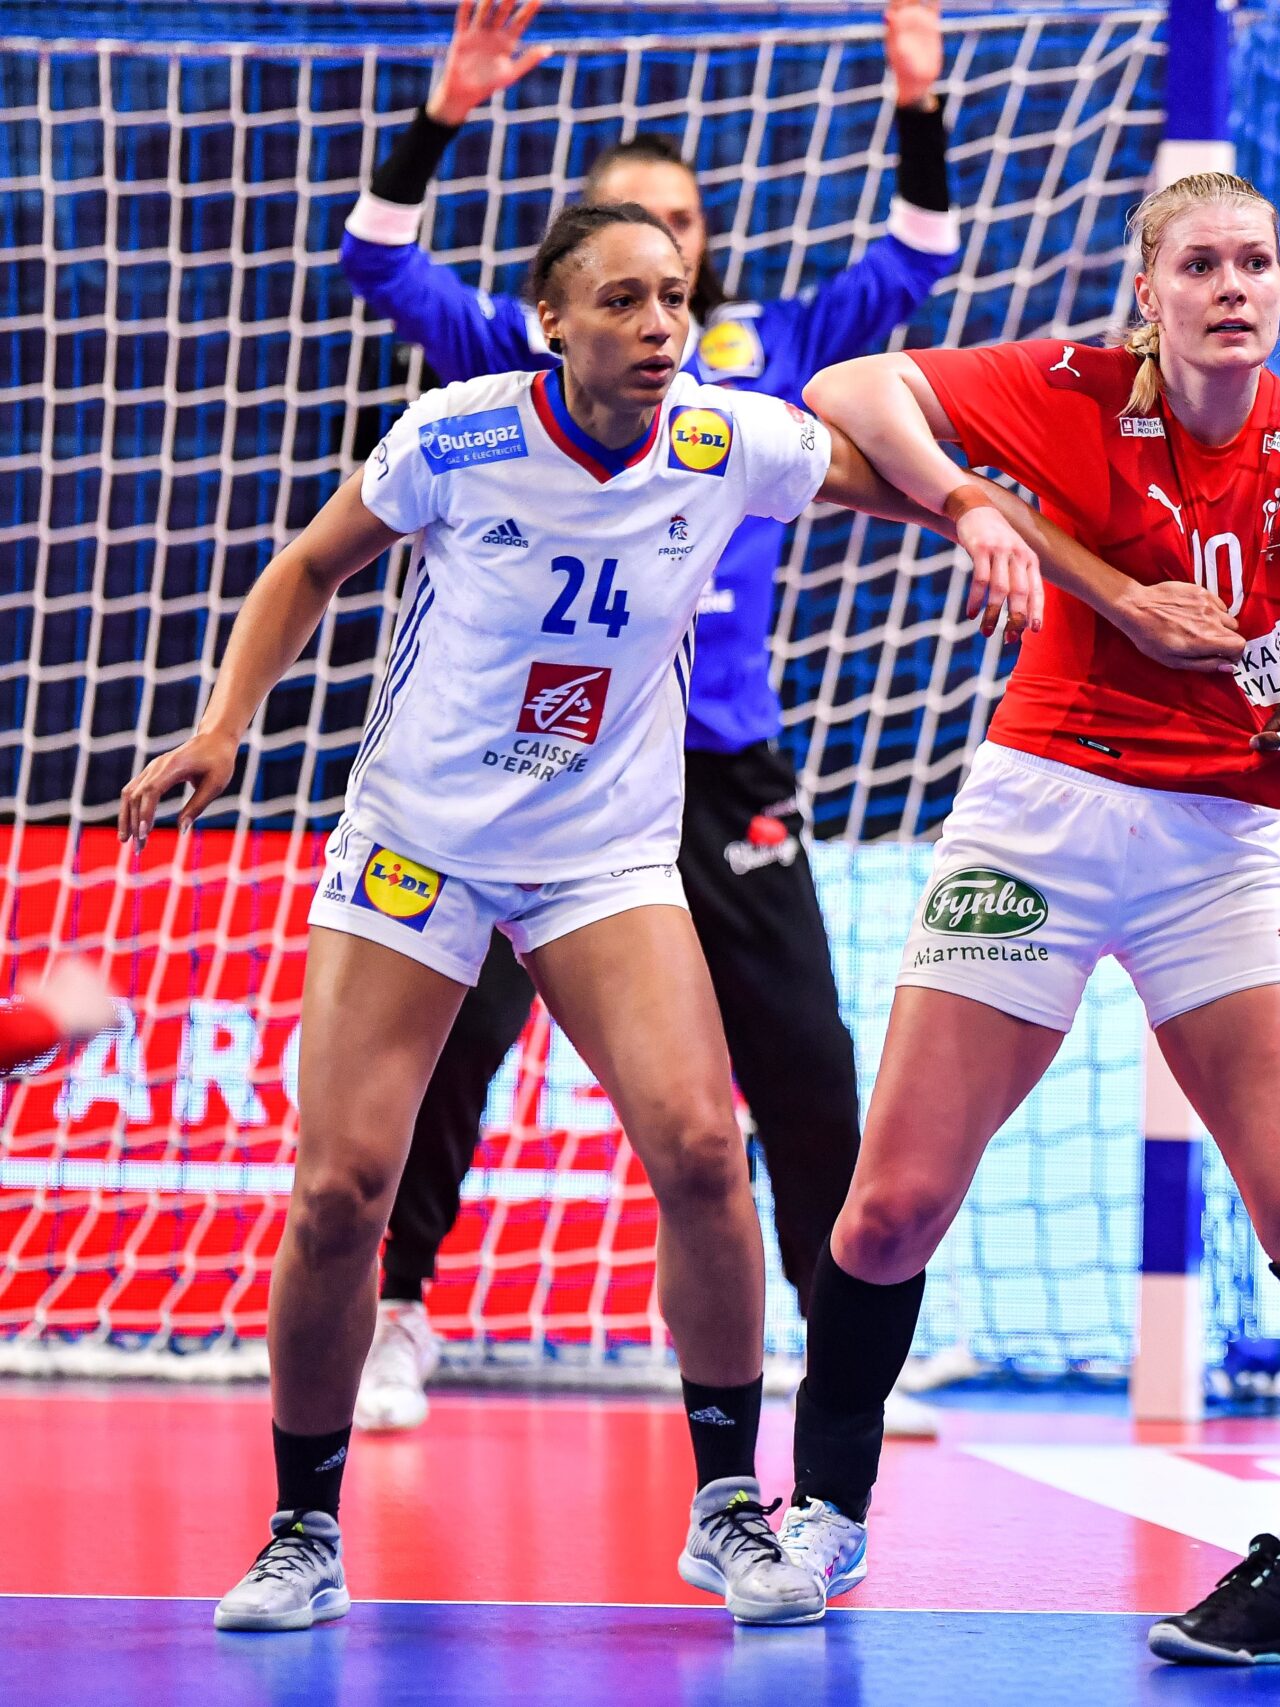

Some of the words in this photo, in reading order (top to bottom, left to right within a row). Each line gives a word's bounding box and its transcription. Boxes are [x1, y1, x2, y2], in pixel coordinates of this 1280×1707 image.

[437, 425, 520, 453] Butagaz
[482, 534, 529, 548] adidas
[1192, 528, 1244, 618] 10
[541, 555, 630, 638] 24
[928, 879, 1045, 928] Fynbo
[914, 943, 1049, 969] Marmelade
